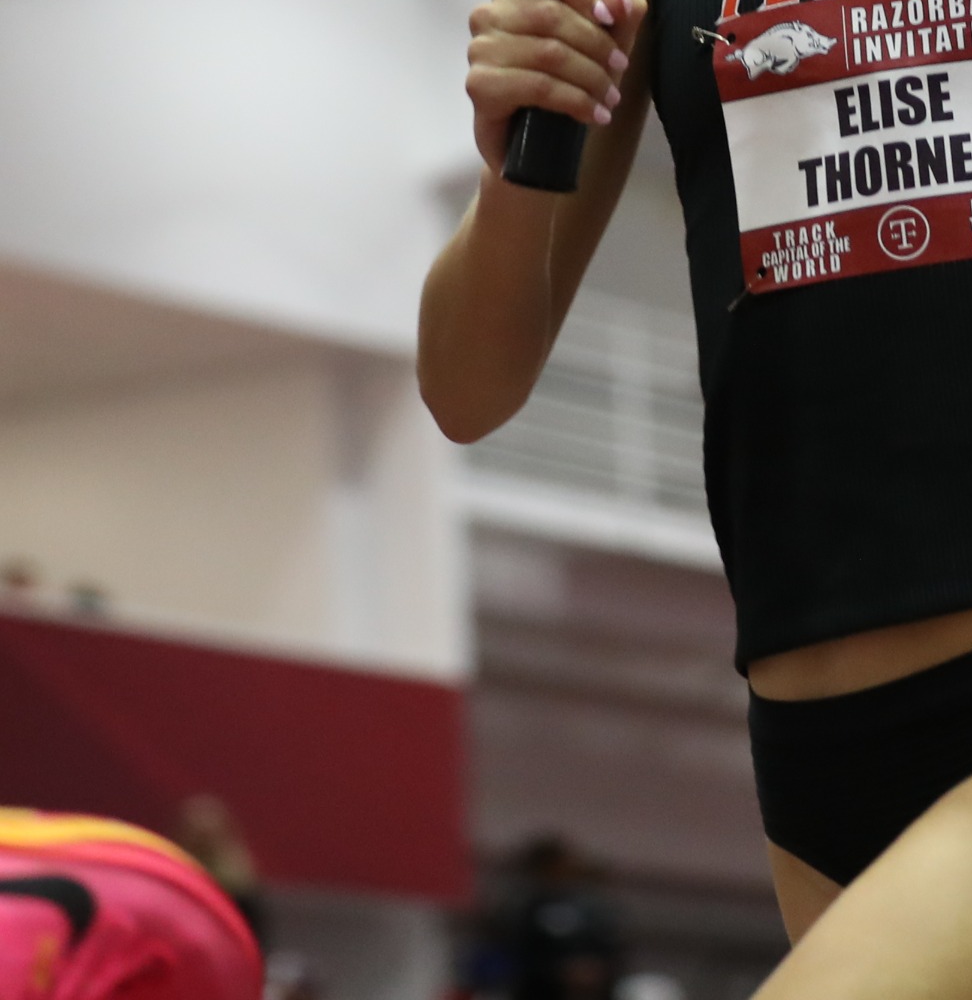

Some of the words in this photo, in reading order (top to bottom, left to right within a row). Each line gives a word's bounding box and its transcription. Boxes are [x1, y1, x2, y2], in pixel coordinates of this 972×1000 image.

[834, 72, 954, 138] ELISE
[773, 220, 837, 250] TRACK
[762, 246, 809, 268] CAPITAL
[811, 241, 826, 257] OF
[827, 236, 851, 254] THE
[773, 254, 842, 284] WORLD
